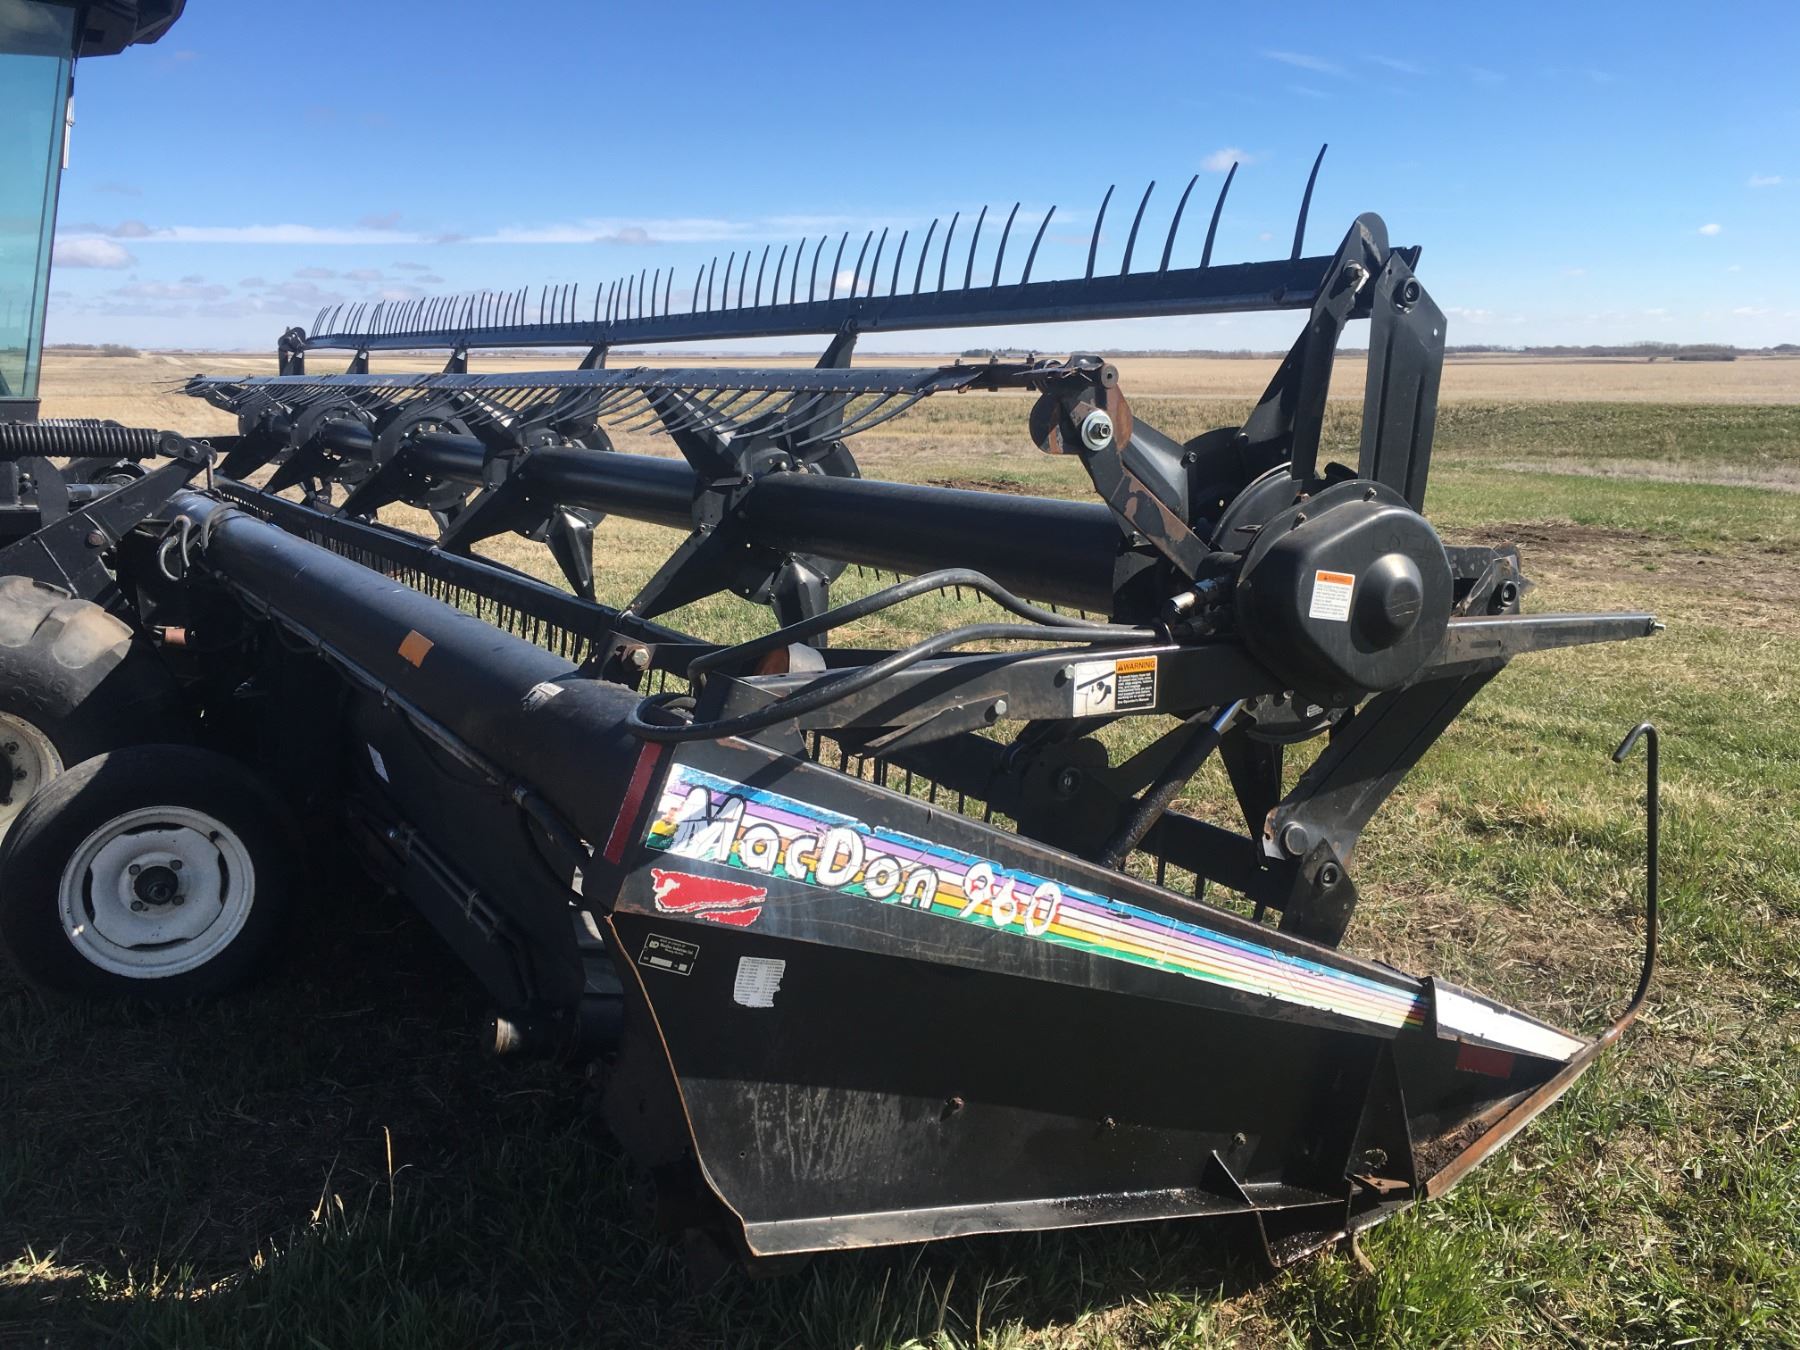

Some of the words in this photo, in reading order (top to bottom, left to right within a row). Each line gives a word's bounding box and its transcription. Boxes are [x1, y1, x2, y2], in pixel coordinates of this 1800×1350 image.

[1123, 660, 1155, 671] WARNING
[672, 785, 940, 910] MacDon
[957, 861, 1061, 936] 960
